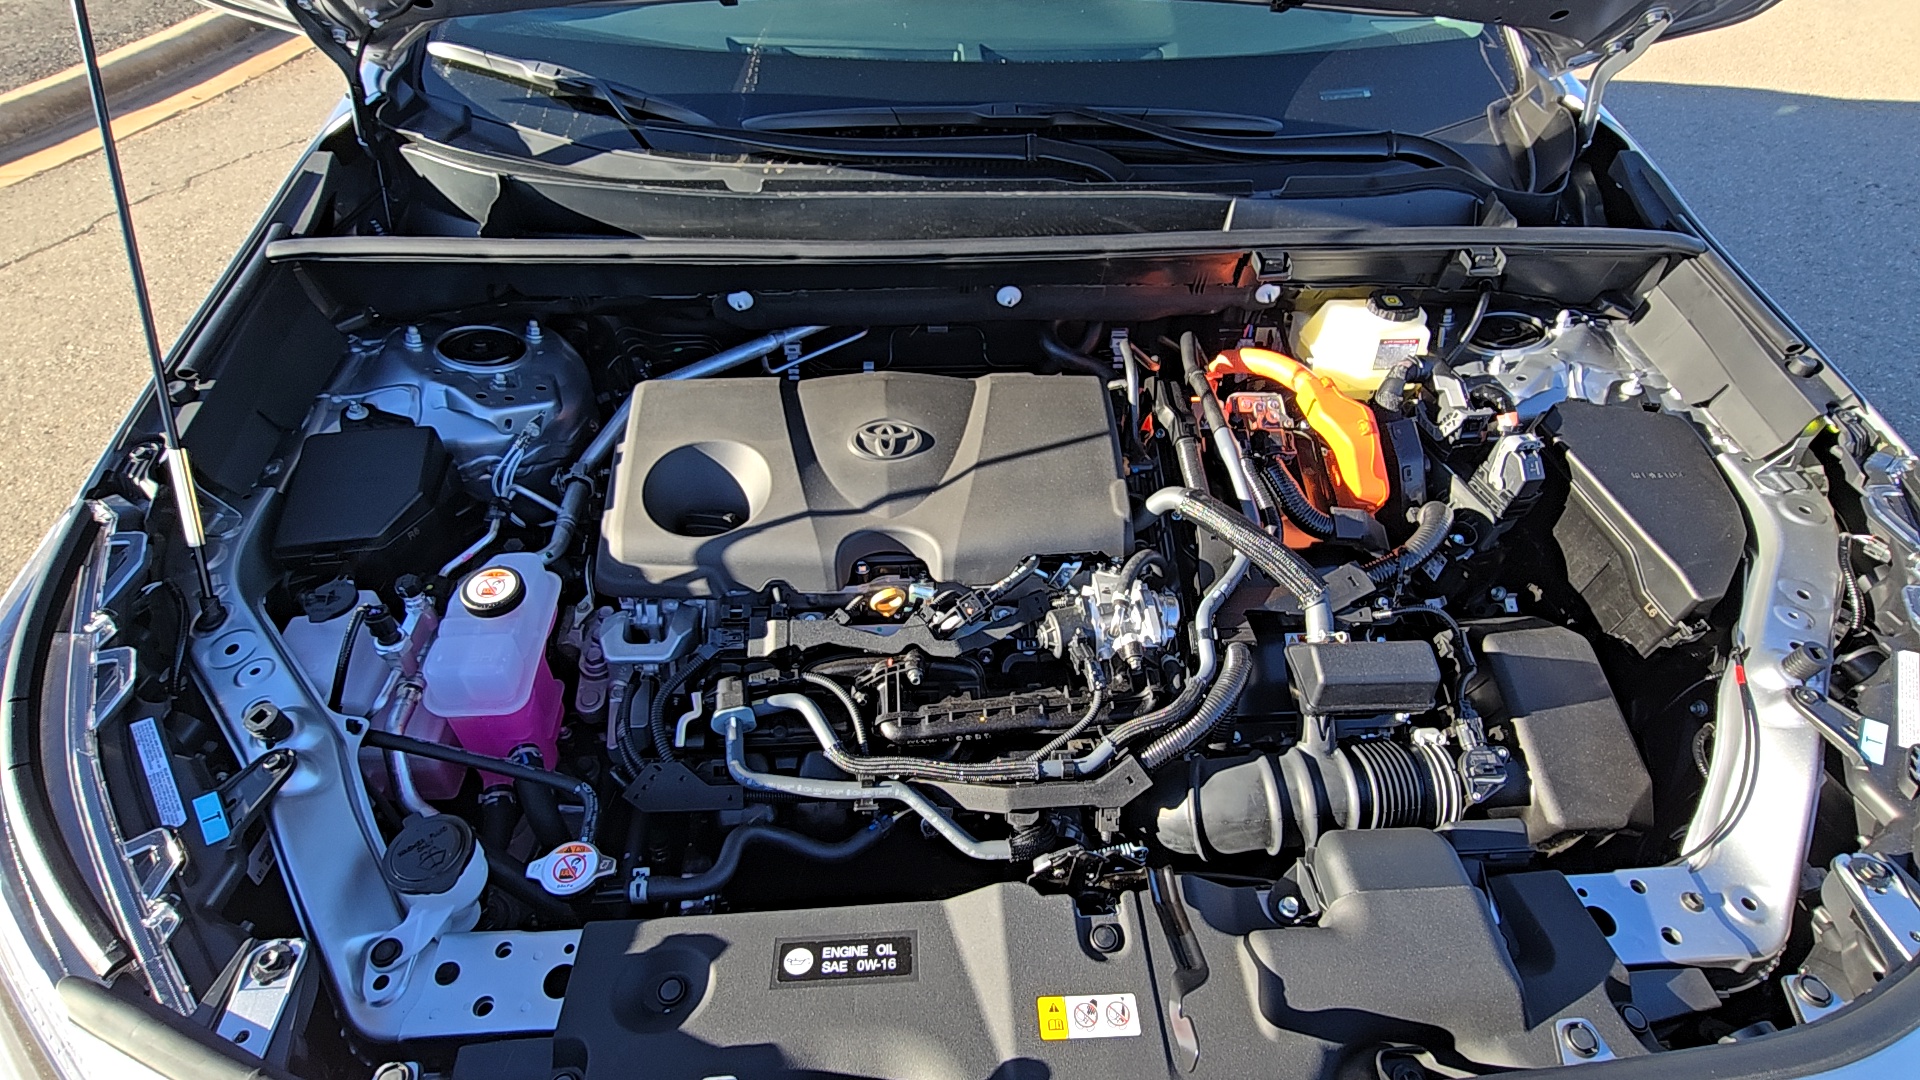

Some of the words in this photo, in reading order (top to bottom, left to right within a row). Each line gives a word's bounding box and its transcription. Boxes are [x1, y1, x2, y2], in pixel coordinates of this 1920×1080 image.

[1643, 602, 1658, 618] L6
[822, 945, 869, 958] ENGINE
[875, 943, 897, 956] OIL
[821, 960, 848, 973] SAE
[856, 957, 897, 972] 0W-16
